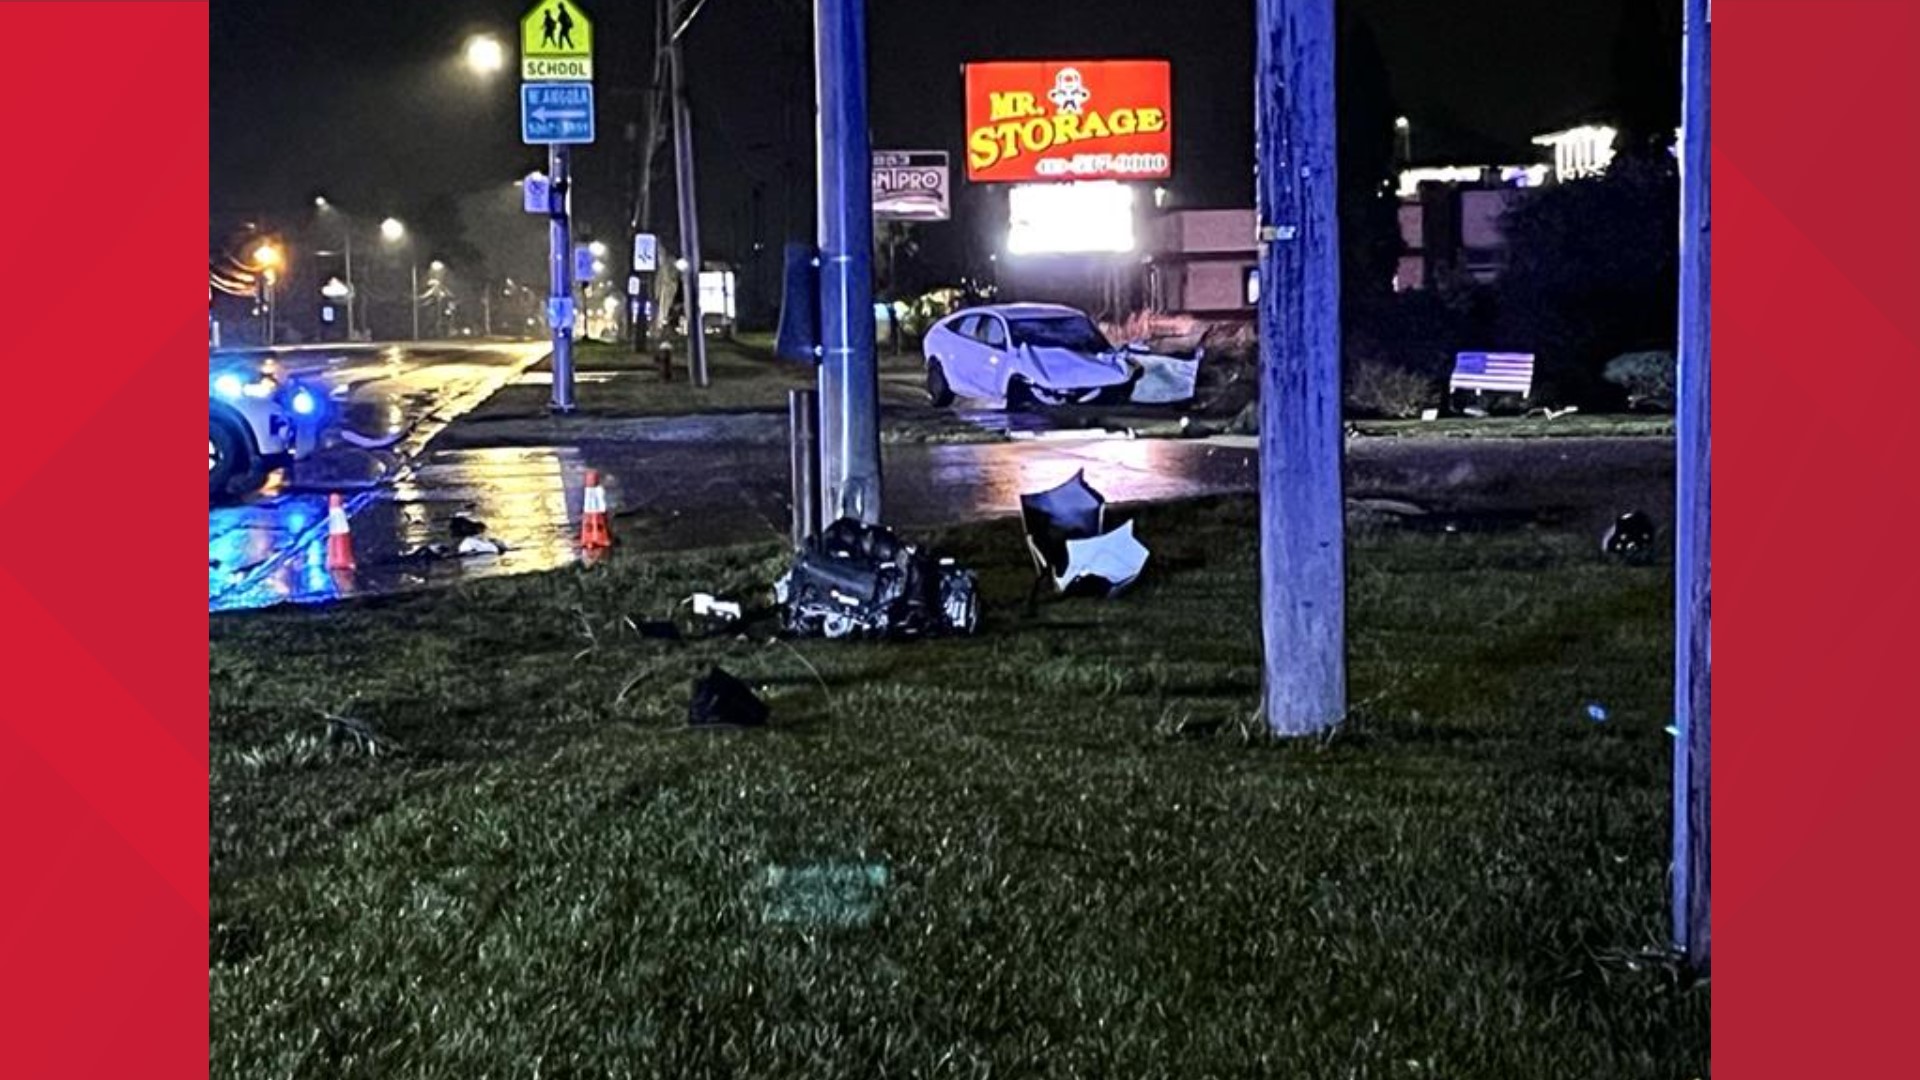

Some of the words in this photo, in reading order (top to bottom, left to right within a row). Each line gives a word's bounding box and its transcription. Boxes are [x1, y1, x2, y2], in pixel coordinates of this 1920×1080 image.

[527, 61, 587, 76] SCHOOL
[989, 91, 1046, 121] MR.
[969, 108, 1165, 169] STORAGE
